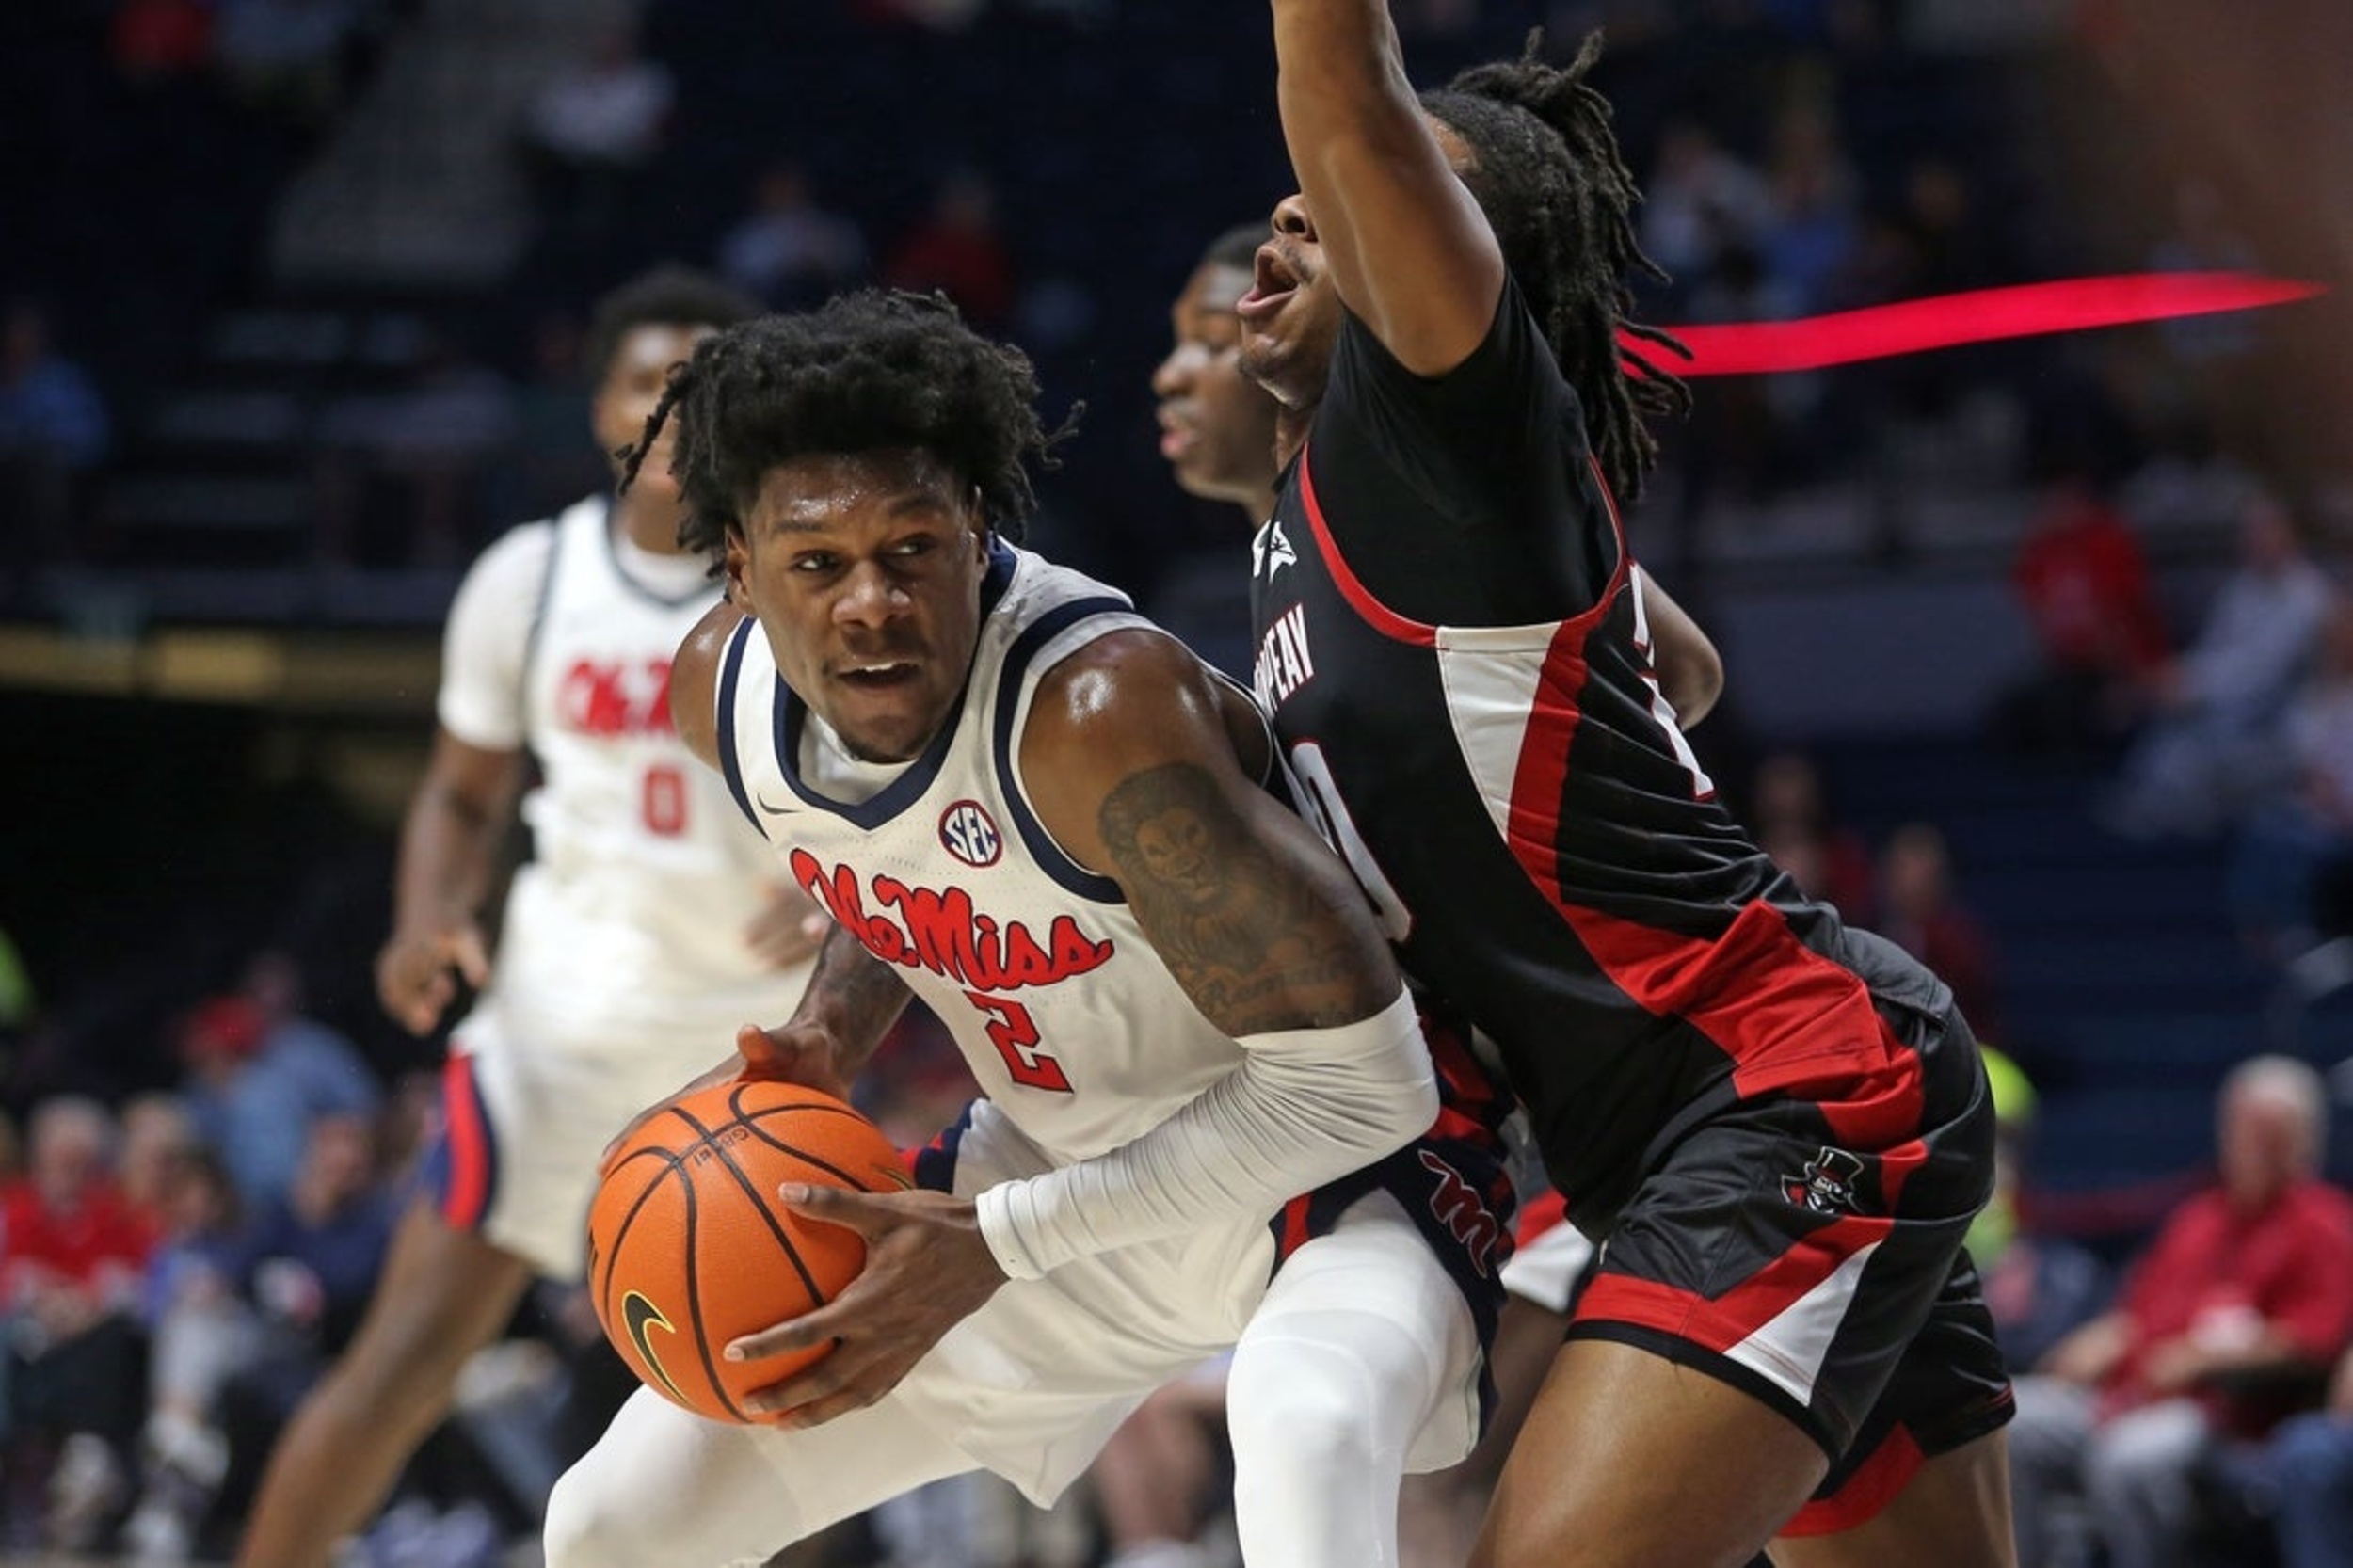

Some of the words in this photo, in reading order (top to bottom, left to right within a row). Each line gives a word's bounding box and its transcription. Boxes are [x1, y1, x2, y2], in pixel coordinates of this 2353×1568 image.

[642, 765, 687, 836] 0
[944, 806, 999, 863] SEC
[872, 874, 1114, 991] Miss
[963, 990, 1074, 1093] 2
